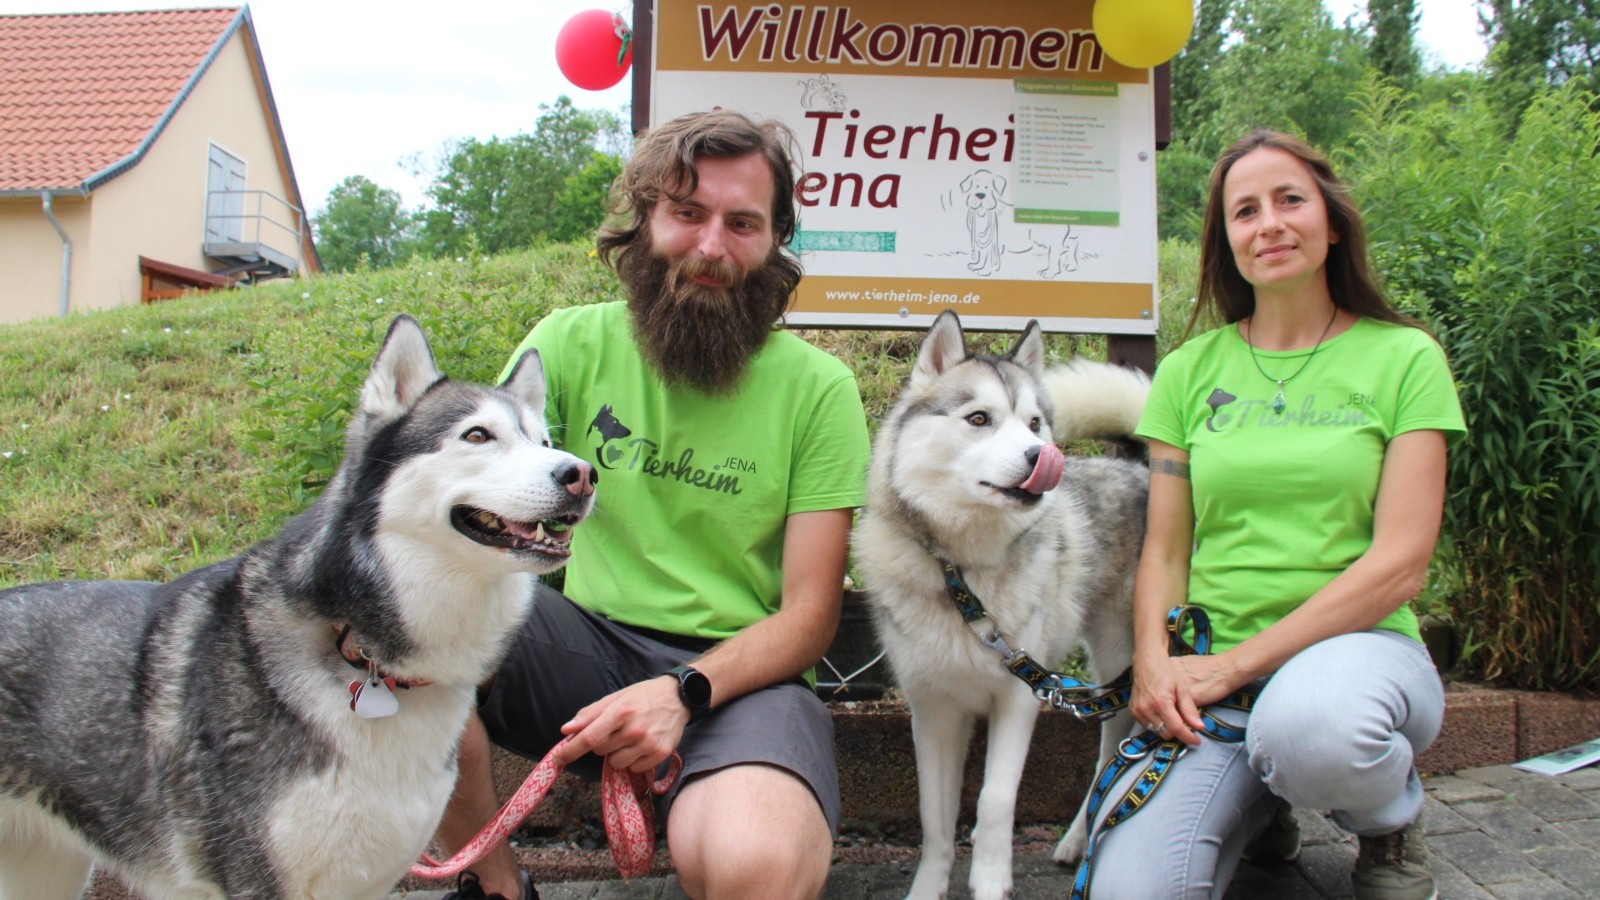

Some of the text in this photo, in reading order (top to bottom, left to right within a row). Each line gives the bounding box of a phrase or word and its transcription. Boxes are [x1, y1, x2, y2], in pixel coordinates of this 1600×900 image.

[698, 3, 1104, 72] Willkommen
[805, 109, 1014, 162] Tierhei
[794, 172, 901, 208] ena
[825, 288, 980, 305] www.tierheim-jena.de
[628, 437, 742, 495] Tierheim
[722, 456, 757, 474] JENA
